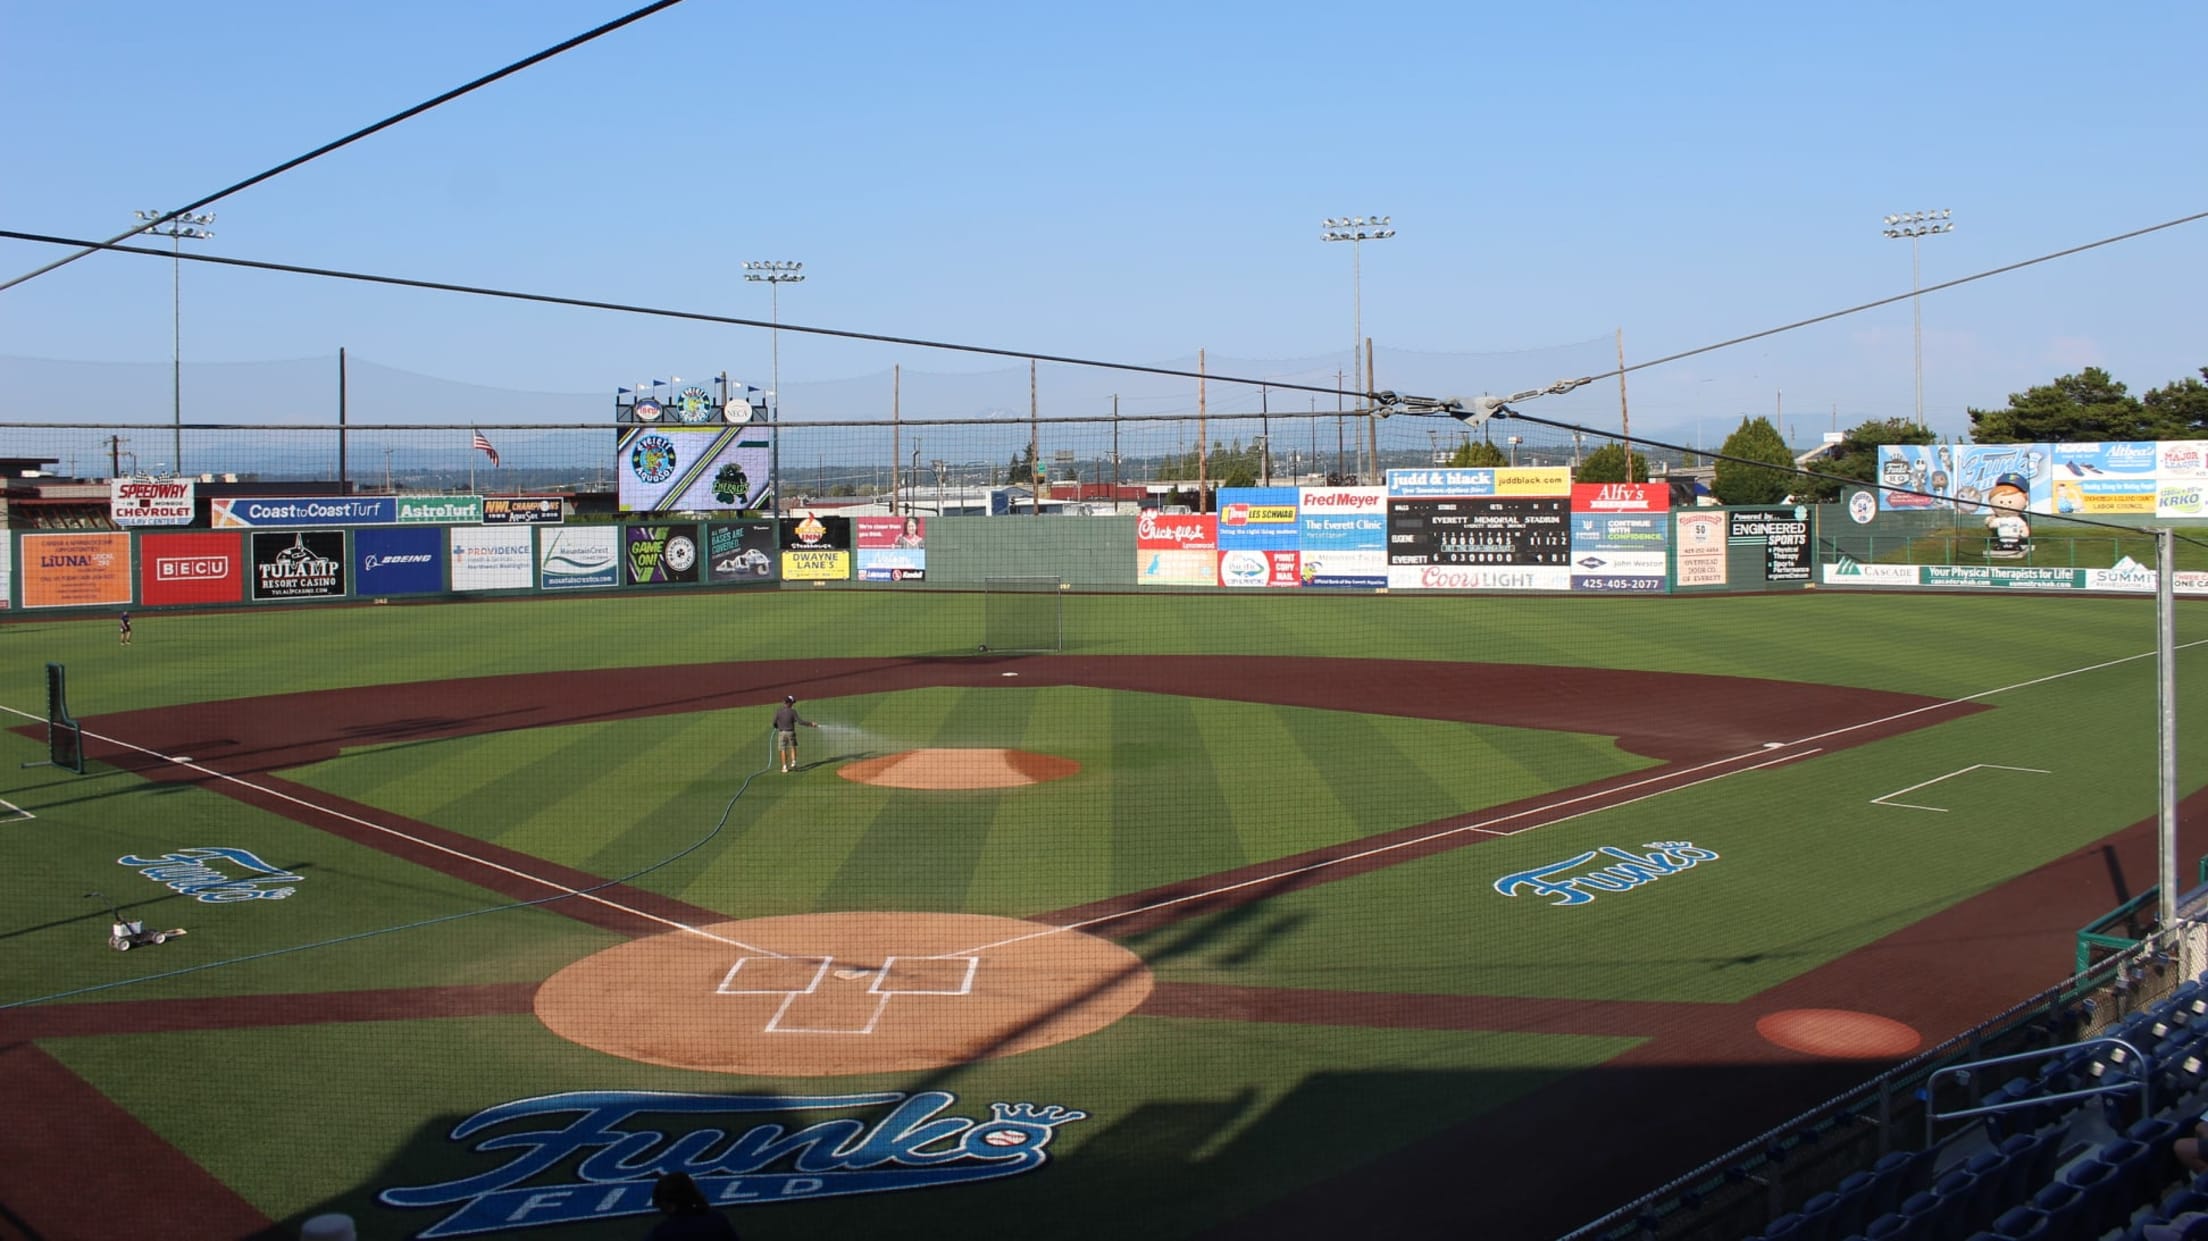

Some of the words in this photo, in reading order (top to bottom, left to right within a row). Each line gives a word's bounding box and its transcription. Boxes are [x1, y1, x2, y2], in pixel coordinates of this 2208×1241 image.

[1392, 472, 1428, 490] judd
[1430, 472, 1444, 485] &
[1446, 472, 1491, 485] black
[1498, 477, 1562, 486] juddblack.com
[118, 484, 188, 498] SPEEDWAY
[1598, 484, 1645, 502] Alfy's
[1304, 493, 1336, 506] Fred
[1336, 493, 1380, 508] Meyer
[2160, 494, 2199, 508] KRKO
[116, 508, 190, 517] CHEVROLET
[400, 504, 476, 516] AstroTurf
[1248, 510, 1260, 518] LES
[1261, 510, 1294, 518] SCHWAB
[1305, 520, 1322, 530] The
[1323, 520, 1355, 530] Everett
[1356, 519, 1382, 529] Clinic
[1696, 525, 1705, 534] 50
[1732, 523, 1806, 535] ENGINEERED
[733, 528, 744, 538] ARE
[1768, 535, 1806, 545] SPORTS
[468, 546, 529, 554] PROVIDENCE
[632, 542, 664, 553] GAME
[42, 555, 91, 567] LiUNA!
[382, 555, 432, 564] BOEING
[638, 553, 658, 566] ON!
[793, 553, 838, 561] DWAYNE
[1392, 555, 1428, 564] EVERETT
[162, 562, 224, 575] BECU
[259, 561, 339, 578] TULALIP
[1929, 568, 1950, 577] Your
[1951, 568, 1989, 579] Physical
[1991, 568, 2037, 580] Therapists
[2039, 569, 2053, 578] for
[2054, 570, 2073, 579] Life!
[262, 578, 298, 589] RESORT
[300, 577, 336, 587] CASINO
[1422, 566, 1478, 588] Coors
[1482, 572, 1534, 586] LIGHT
[1583, 579, 1658, 589] 425-405-2077
[117, 847, 304, 903] Funko
[1494, 841, 1720, 906] Funko
[380, 1090, 1089, 1206] Funko
[504, 1177, 824, 1222] FILD
